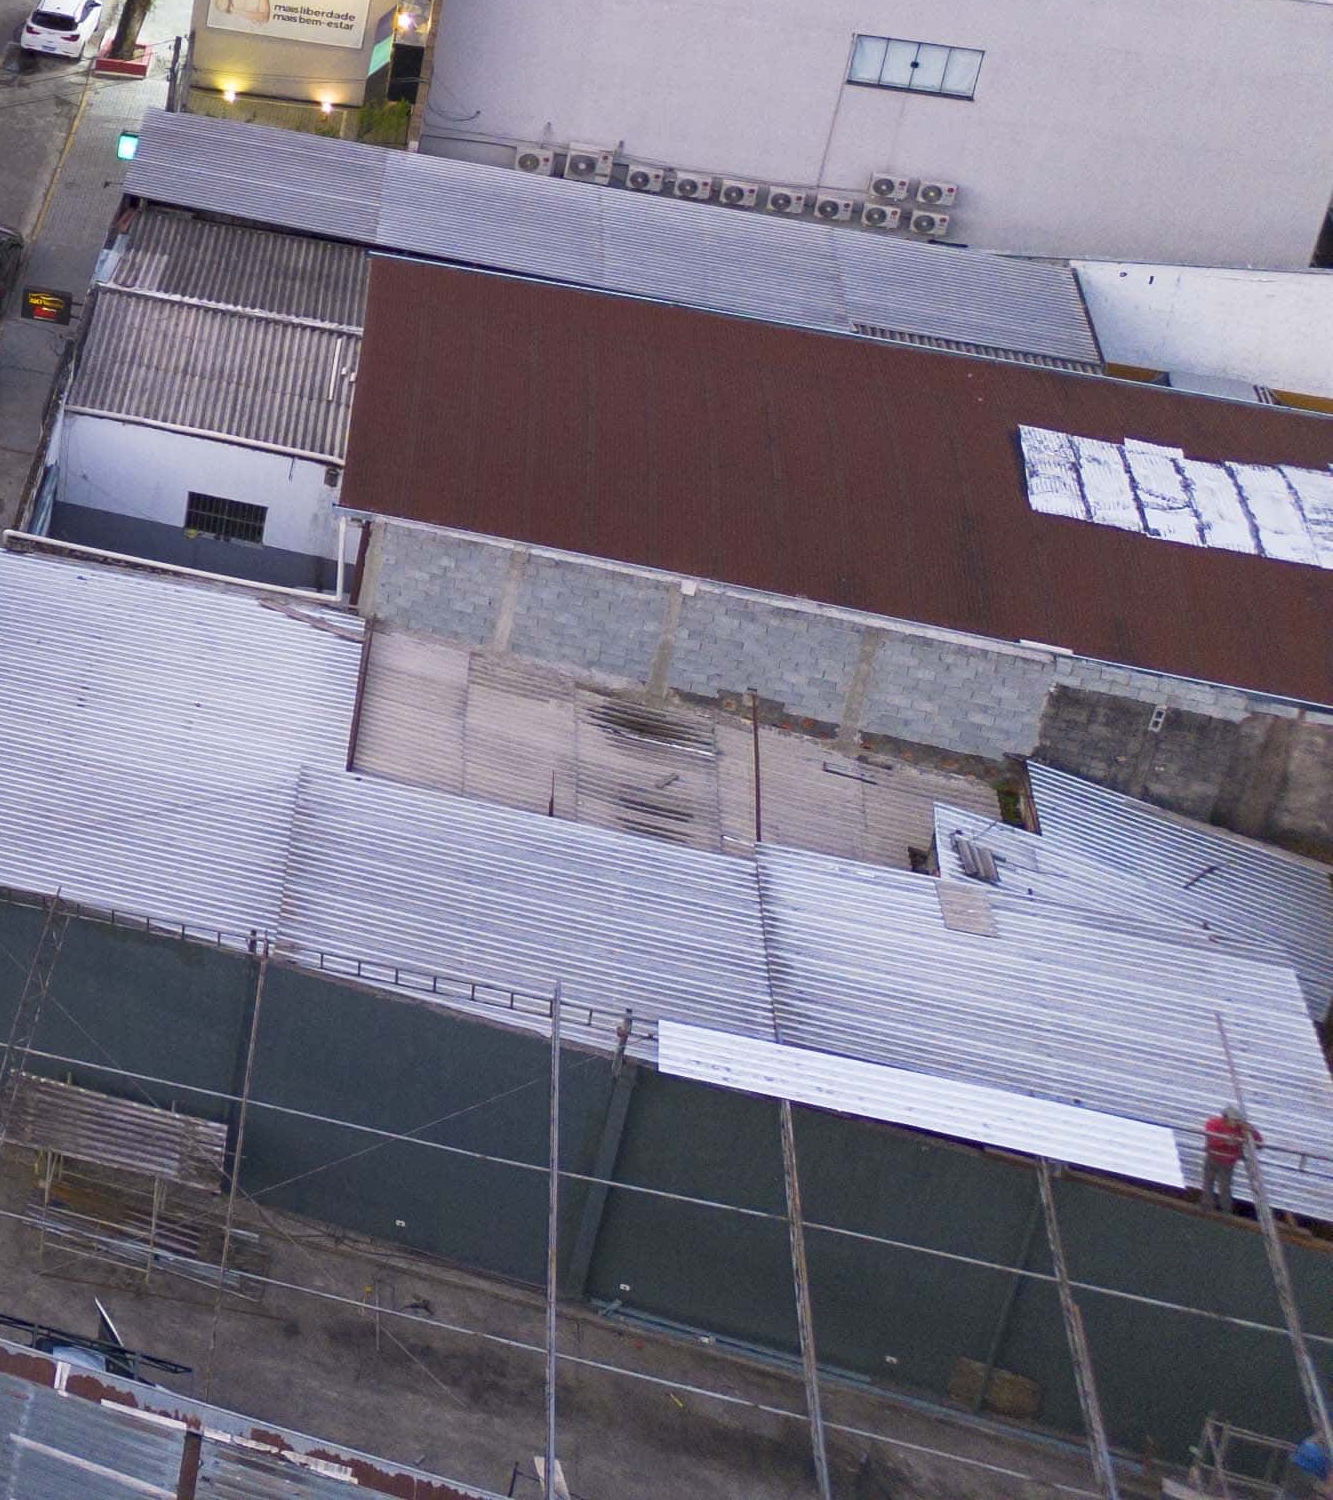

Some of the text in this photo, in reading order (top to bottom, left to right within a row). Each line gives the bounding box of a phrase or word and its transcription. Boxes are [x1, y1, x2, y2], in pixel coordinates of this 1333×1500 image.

[272, 13, 355, 31] mais bem-estar
[274, 4, 356, 22] mais liberdade
